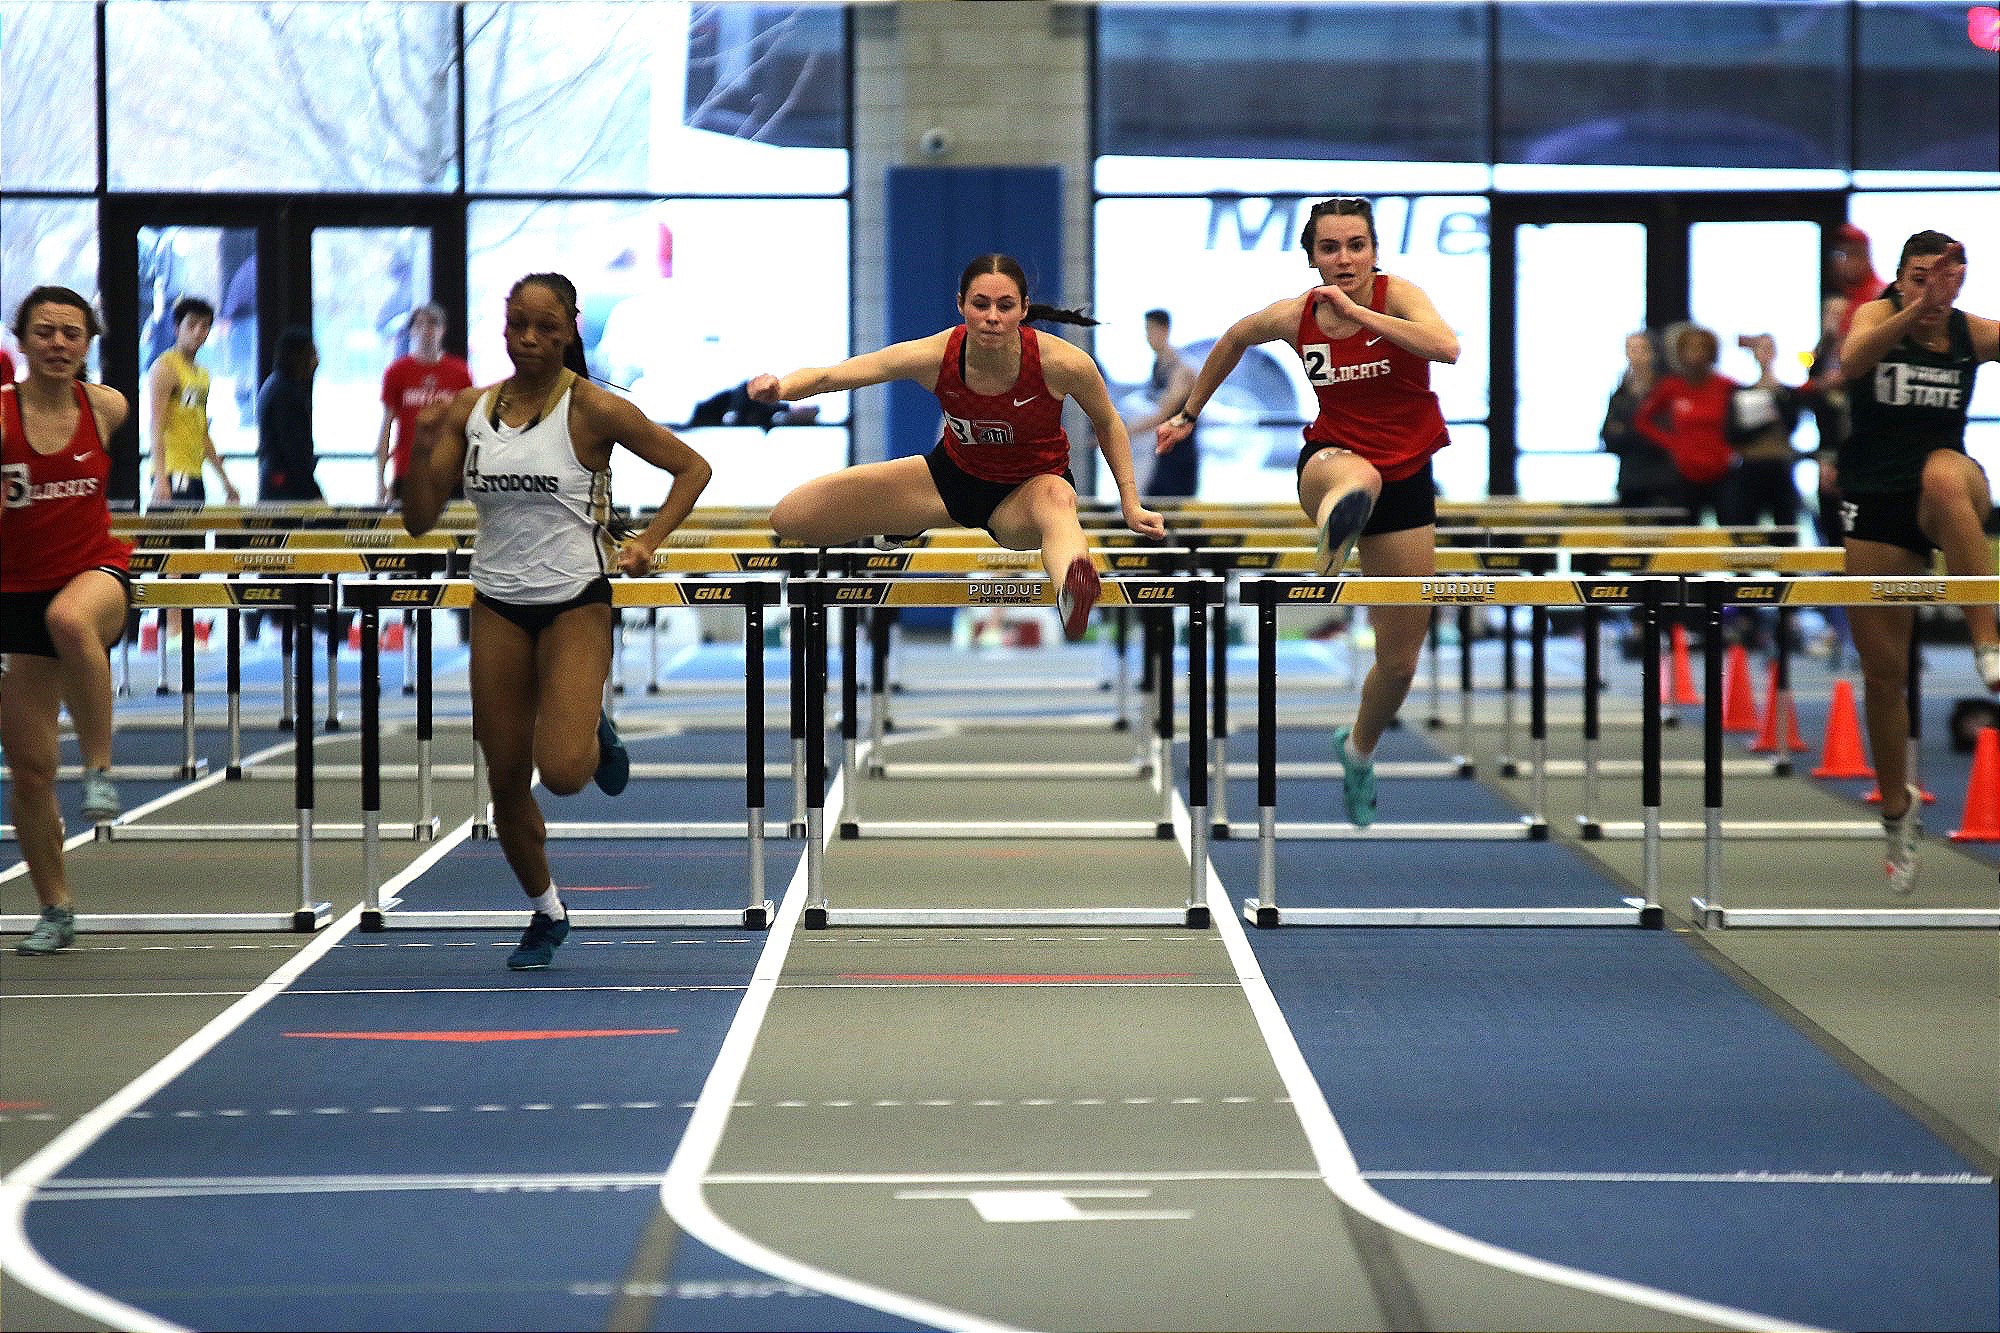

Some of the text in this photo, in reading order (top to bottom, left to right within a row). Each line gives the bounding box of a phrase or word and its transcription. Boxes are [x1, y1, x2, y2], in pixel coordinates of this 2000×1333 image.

[1306, 351, 1328, 380] 2
[1331, 358, 1391, 383] LDCATS
[1885, 366, 1897, 402] 1
[467, 445, 480, 485] 4
[32, 478, 98, 500] LDCATS
[474, 474, 559, 493] STODONS
[234, 555, 296, 564] PURDUE
[375, 557, 406, 568] GILL
[747, 557, 780, 567] GILL
[866, 556, 898, 567] GILL
[243, 588, 282, 600] GILL
[694, 587, 732, 600] GILL
[835, 587, 873, 600] GILL
[969, 583, 1042, 596] PURDUE
[1137, 587, 1175, 600] GILL
[1288, 586, 1326, 599] GILL
[1422, 583, 1496, 595] PURDUE
[1590, 586, 1630, 599] GILL
[1735, 586, 1775, 599] GILL
[1872, 582, 1947, 594] PURDUE
[391, 589, 429, 602] GILL
